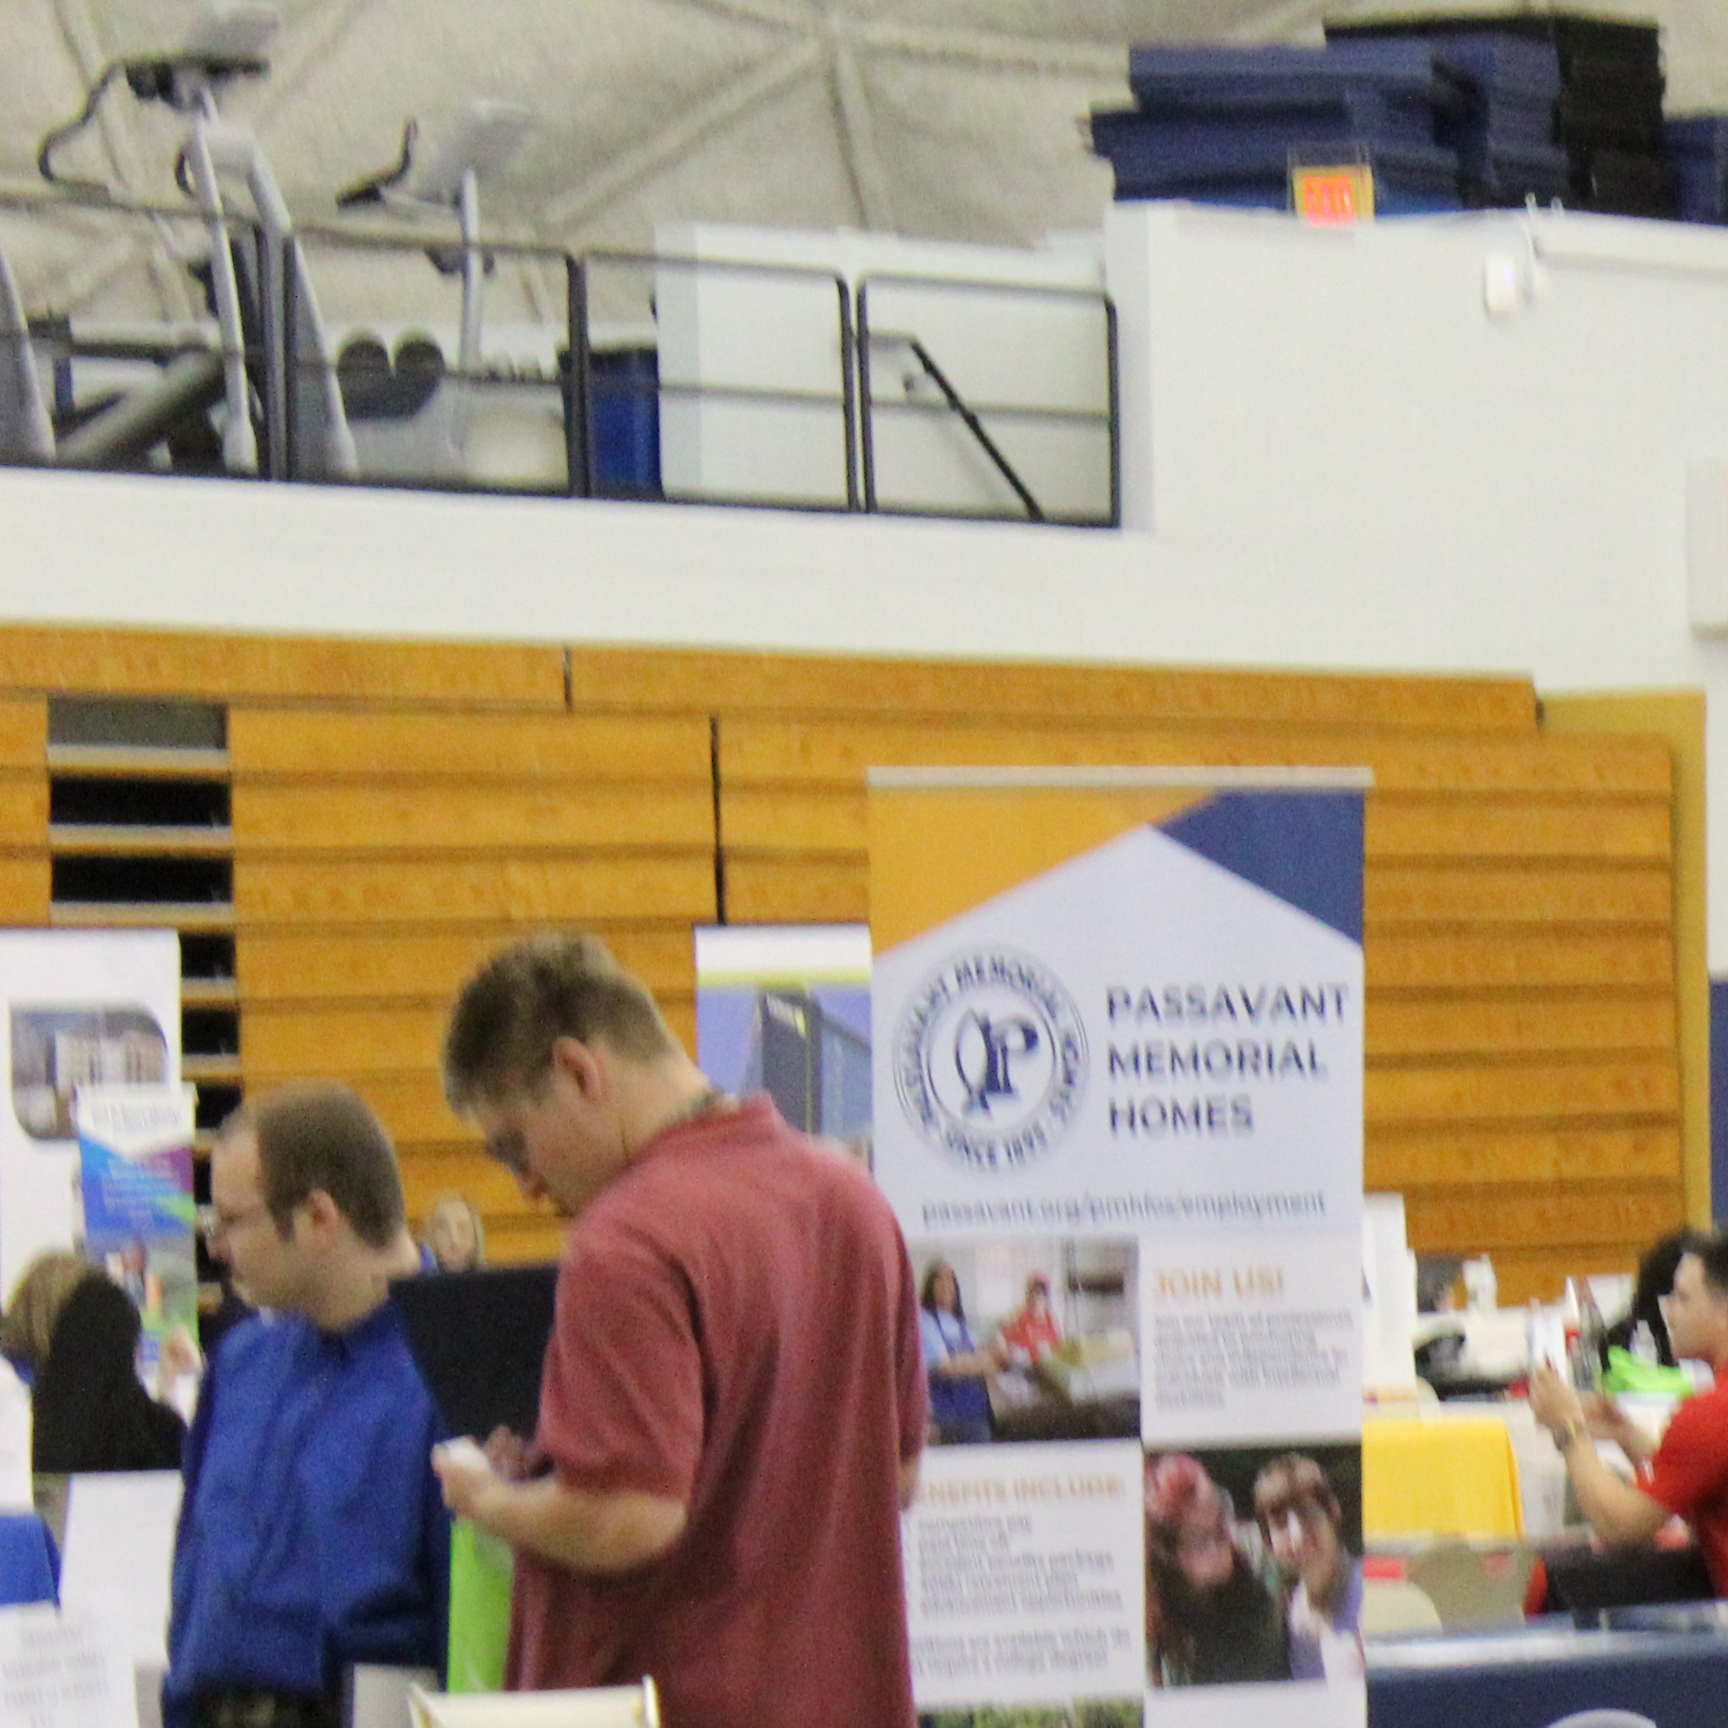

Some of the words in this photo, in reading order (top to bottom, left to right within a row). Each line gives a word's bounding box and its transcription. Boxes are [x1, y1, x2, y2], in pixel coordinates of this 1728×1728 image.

[1106, 982, 1349, 1026] PASSAVANT
[1107, 1039, 1328, 1082] MEMORIAL
[1108, 1095, 1254, 1138] HOMES
[1154, 1266, 1222, 1300] JOIN
